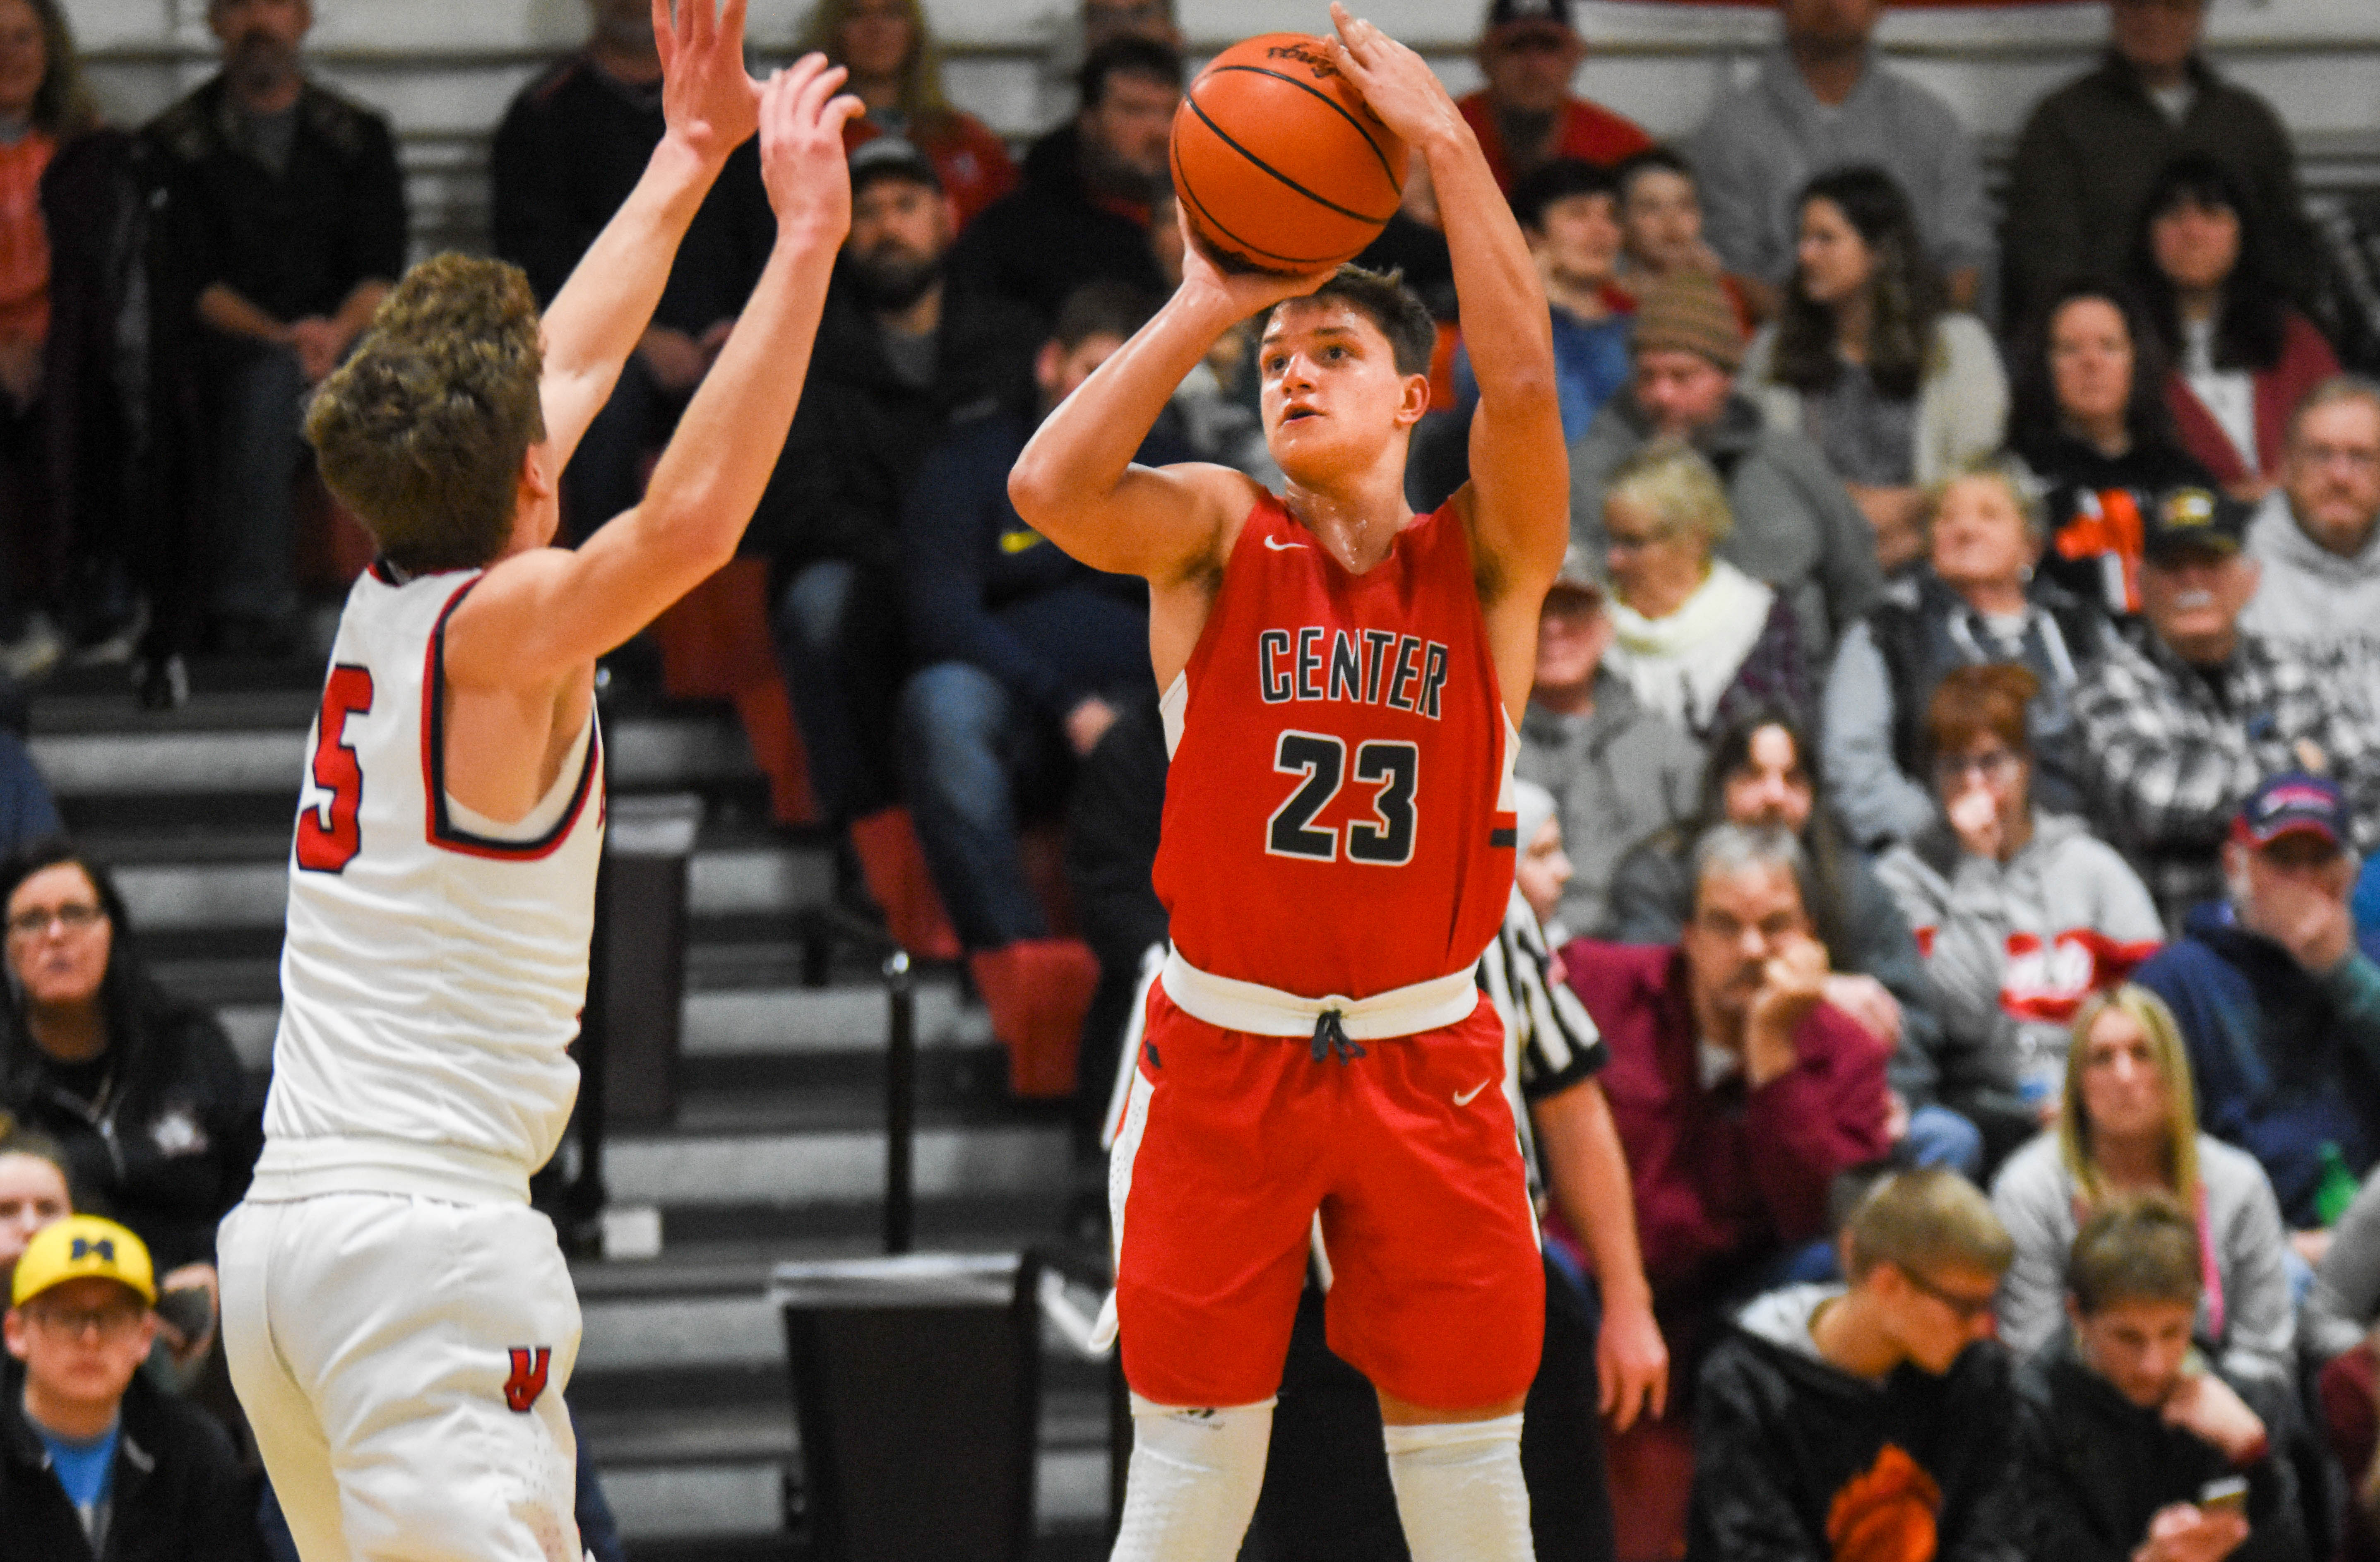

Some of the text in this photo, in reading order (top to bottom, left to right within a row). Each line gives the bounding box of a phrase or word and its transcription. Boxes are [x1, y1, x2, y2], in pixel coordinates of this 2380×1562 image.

[1259, 626, 1448, 720] CENTER
[296, 663, 373, 875] 5
[1265, 730, 1418, 866] 23
